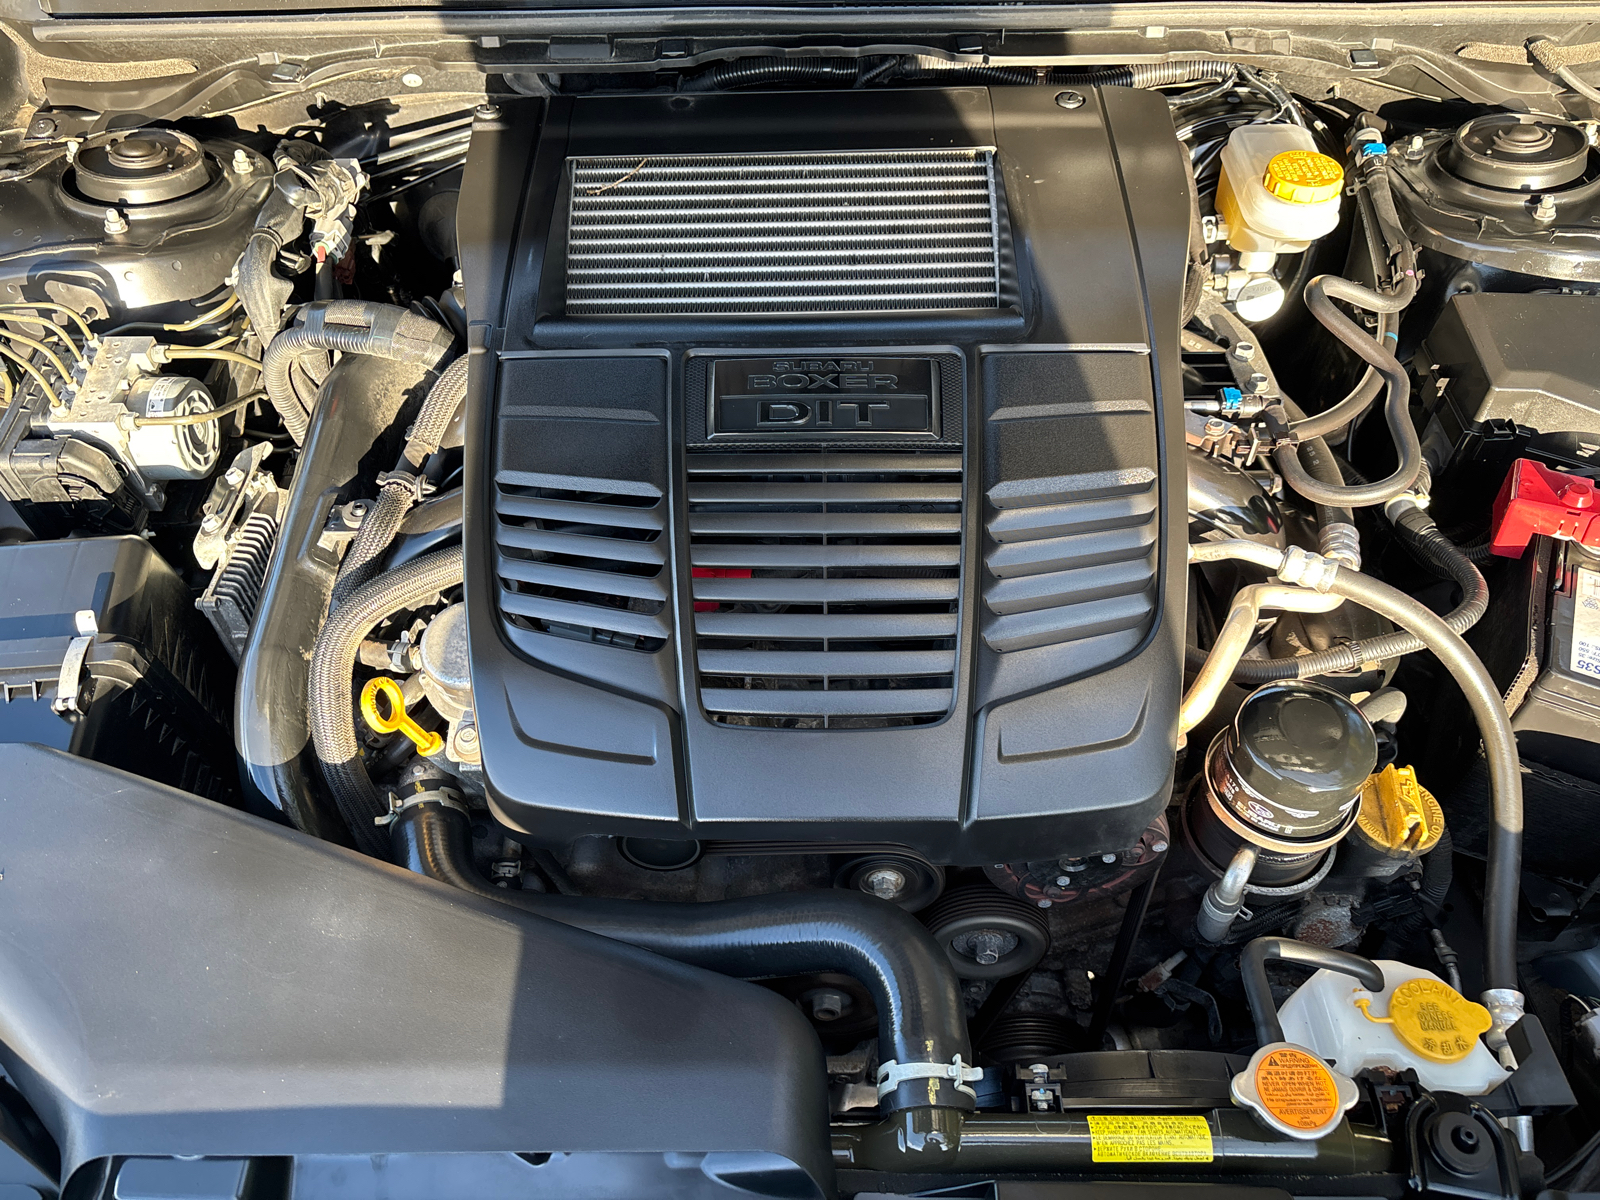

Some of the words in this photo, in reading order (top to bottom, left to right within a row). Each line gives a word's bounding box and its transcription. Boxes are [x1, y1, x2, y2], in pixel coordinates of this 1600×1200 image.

[772, 360, 874, 372] SUBARU
[747, 373, 898, 389] BOXER
[757, 400, 890, 426] DIT
[1417, 786, 1443, 824] ENGINE
[1358, 814, 1384, 840] MANUAL
[1396, 981, 1463, 1007] COOLANT
[1419, 1002, 1440, 1012] SEE
[1420, 1021, 1457, 1032] MANUAL
